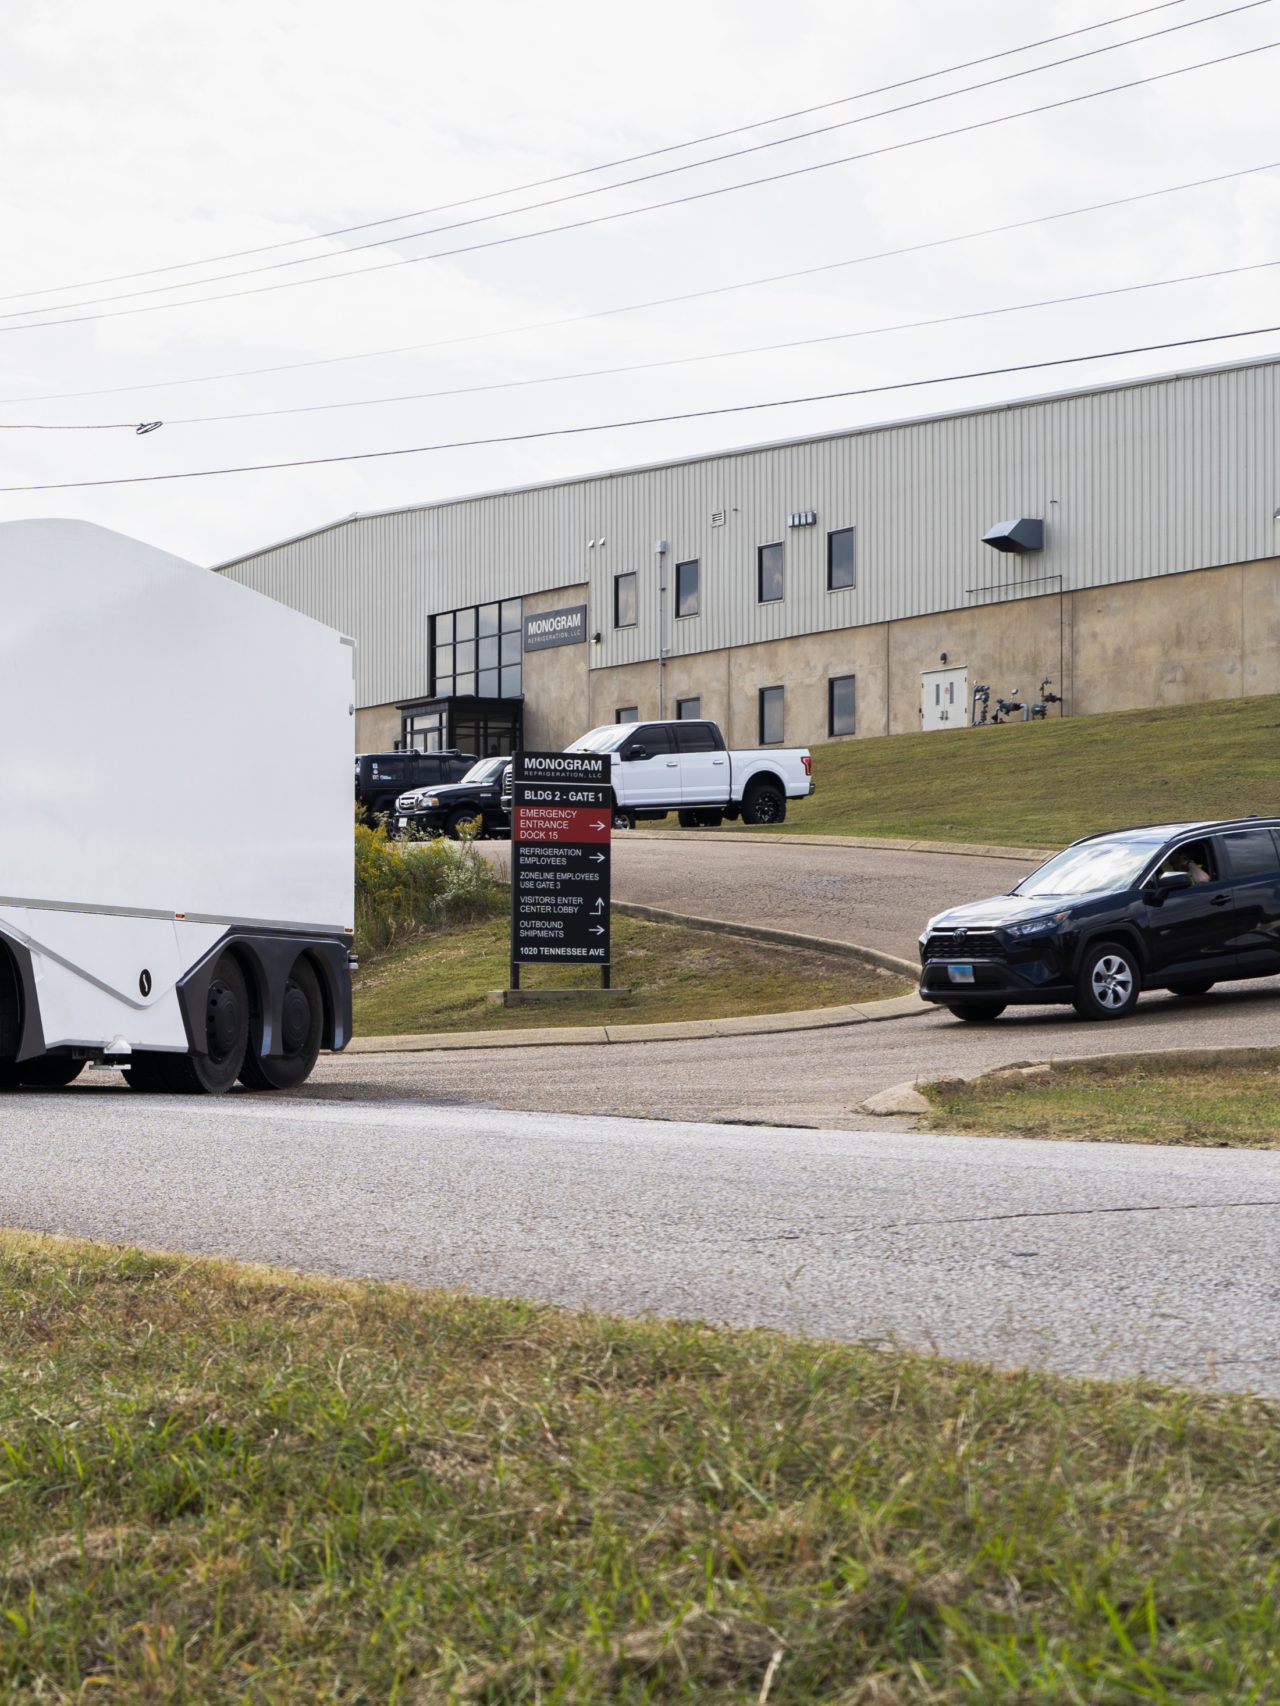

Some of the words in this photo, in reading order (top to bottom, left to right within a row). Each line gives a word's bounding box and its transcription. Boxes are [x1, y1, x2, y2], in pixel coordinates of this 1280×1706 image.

[528, 613, 581, 636] MONOGRAM
[524, 758, 602, 771] MONOGRAM
[524, 790, 552, 800] BLDG
[554, 791, 561, 801] 2
[568, 792, 595, 802] GATE
[597, 793, 603, 802] 1
[520, 809, 578, 818] EMERGENCY
[520, 820, 569, 829] ENTRANCE
[520, 831, 546, 839] DOCK
[548, 831, 558, 840] 15
[520, 847, 582, 856] REFRIGERATION
[520, 857, 567, 865] EMPLOYEES
[520, 872, 555, 880] ZONELINE
[556, 873, 600, 881] EMPLOYEES
[520, 881, 534, 889] USE
[536, 881, 555, 889] GATE
[520, 896, 556, 904] VISITORS
[557, 896, 584, 905] ENTER
[520, 905, 552, 913] CENTER
[553, 906, 579, 914] LOBBY
[520, 920, 564, 929] OUTBOUND
[520, 930, 565, 938] SHIPMENTS
[520, 947, 538, 955] 1020
[539, 947, 588, 956] TENNESSEE
[589, 948, 605, 956] AVE
